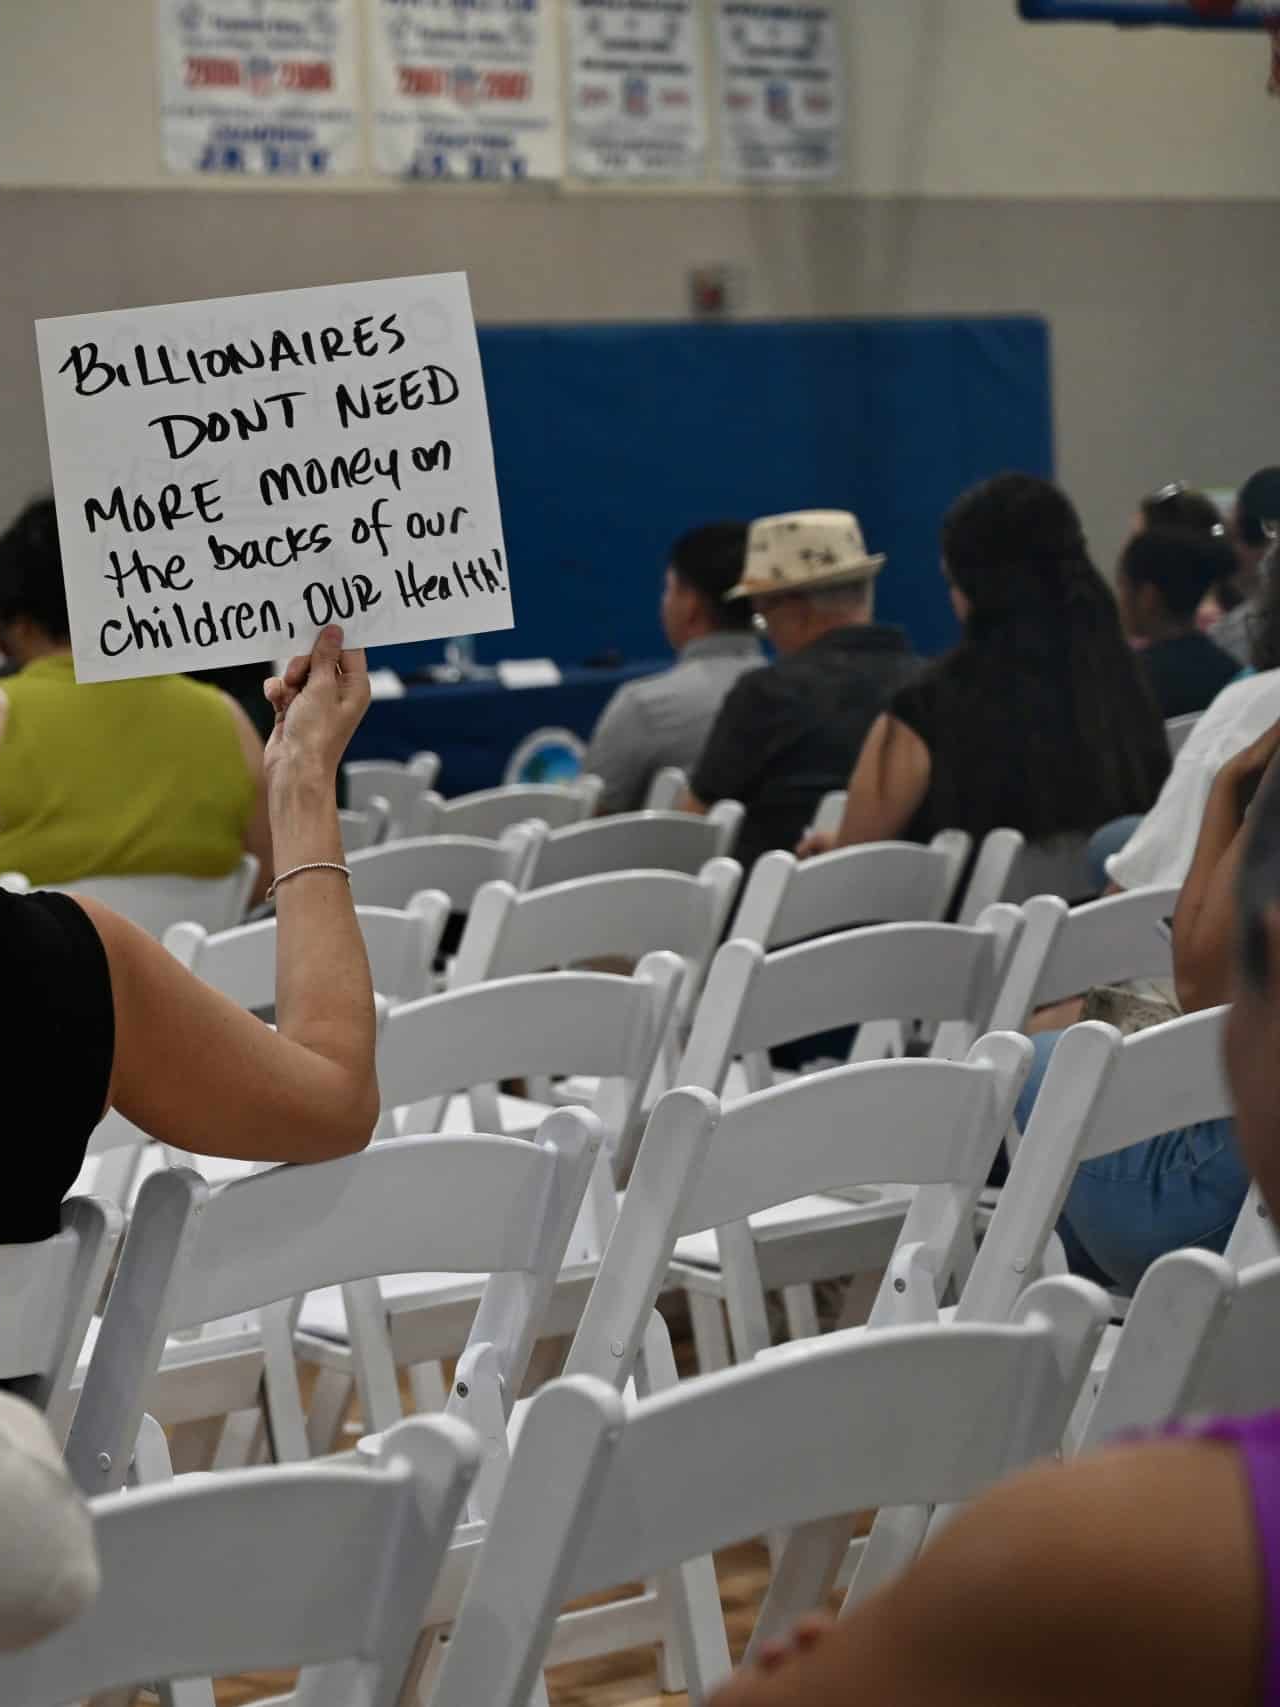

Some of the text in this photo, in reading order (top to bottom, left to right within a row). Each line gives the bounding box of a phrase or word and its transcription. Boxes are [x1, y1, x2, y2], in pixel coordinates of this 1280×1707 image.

[149, 364, 460, 460] DONT NEED
[83, 439, 452, 533] MORE money on
[103, 498, 469, 599] the backs of our
[100, 547, 507, 657] children, OUR Health!
